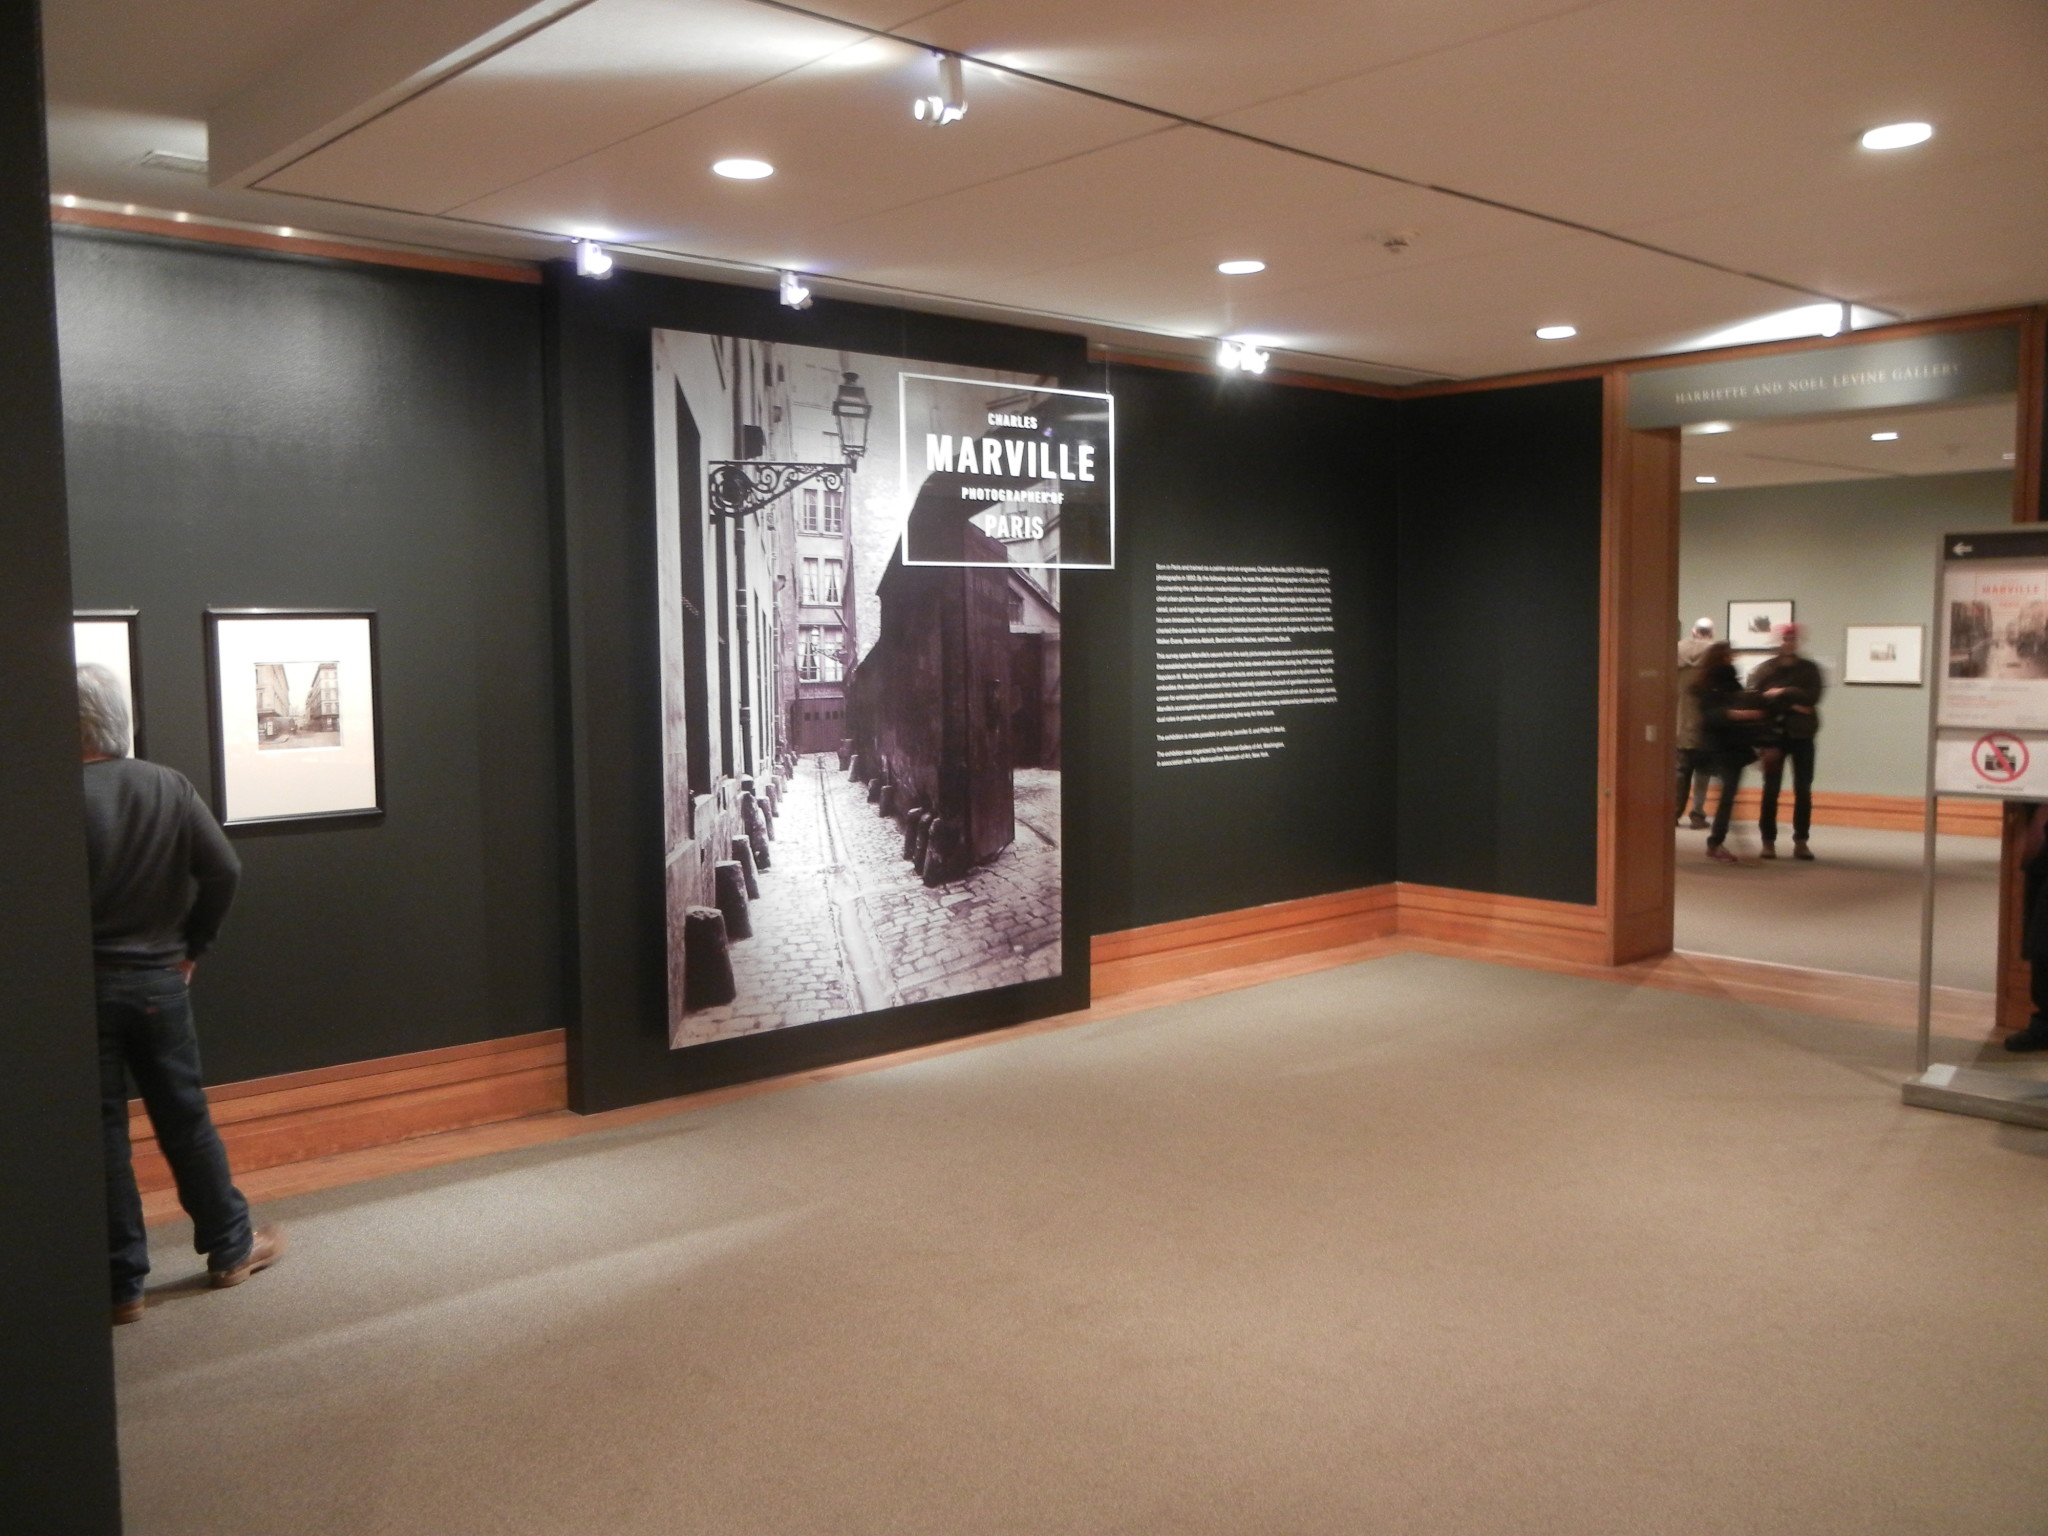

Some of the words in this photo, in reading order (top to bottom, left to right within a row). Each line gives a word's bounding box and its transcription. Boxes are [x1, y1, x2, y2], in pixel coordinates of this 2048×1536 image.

[1675, 385, 1748, 405] HARRIETTE
[1752, 381, 1783, 397] AND
[1789, 378, 1827, 393] NOEL
[1832, 371, 1888, 388] LEVINE
[1891, 363, 1960, 382] GALLERY
[987, 412, 1039, 430] CHARLES
[925, 433, 1096, 483] MARVILLE
[961, 487, 1050, 504] PHOTOGRAPHER
[1050, 491, 1065, 505] OF
[985, 514, 1045, 540] PARIS
[1981, 583, 2041, 595] MARVILLE
